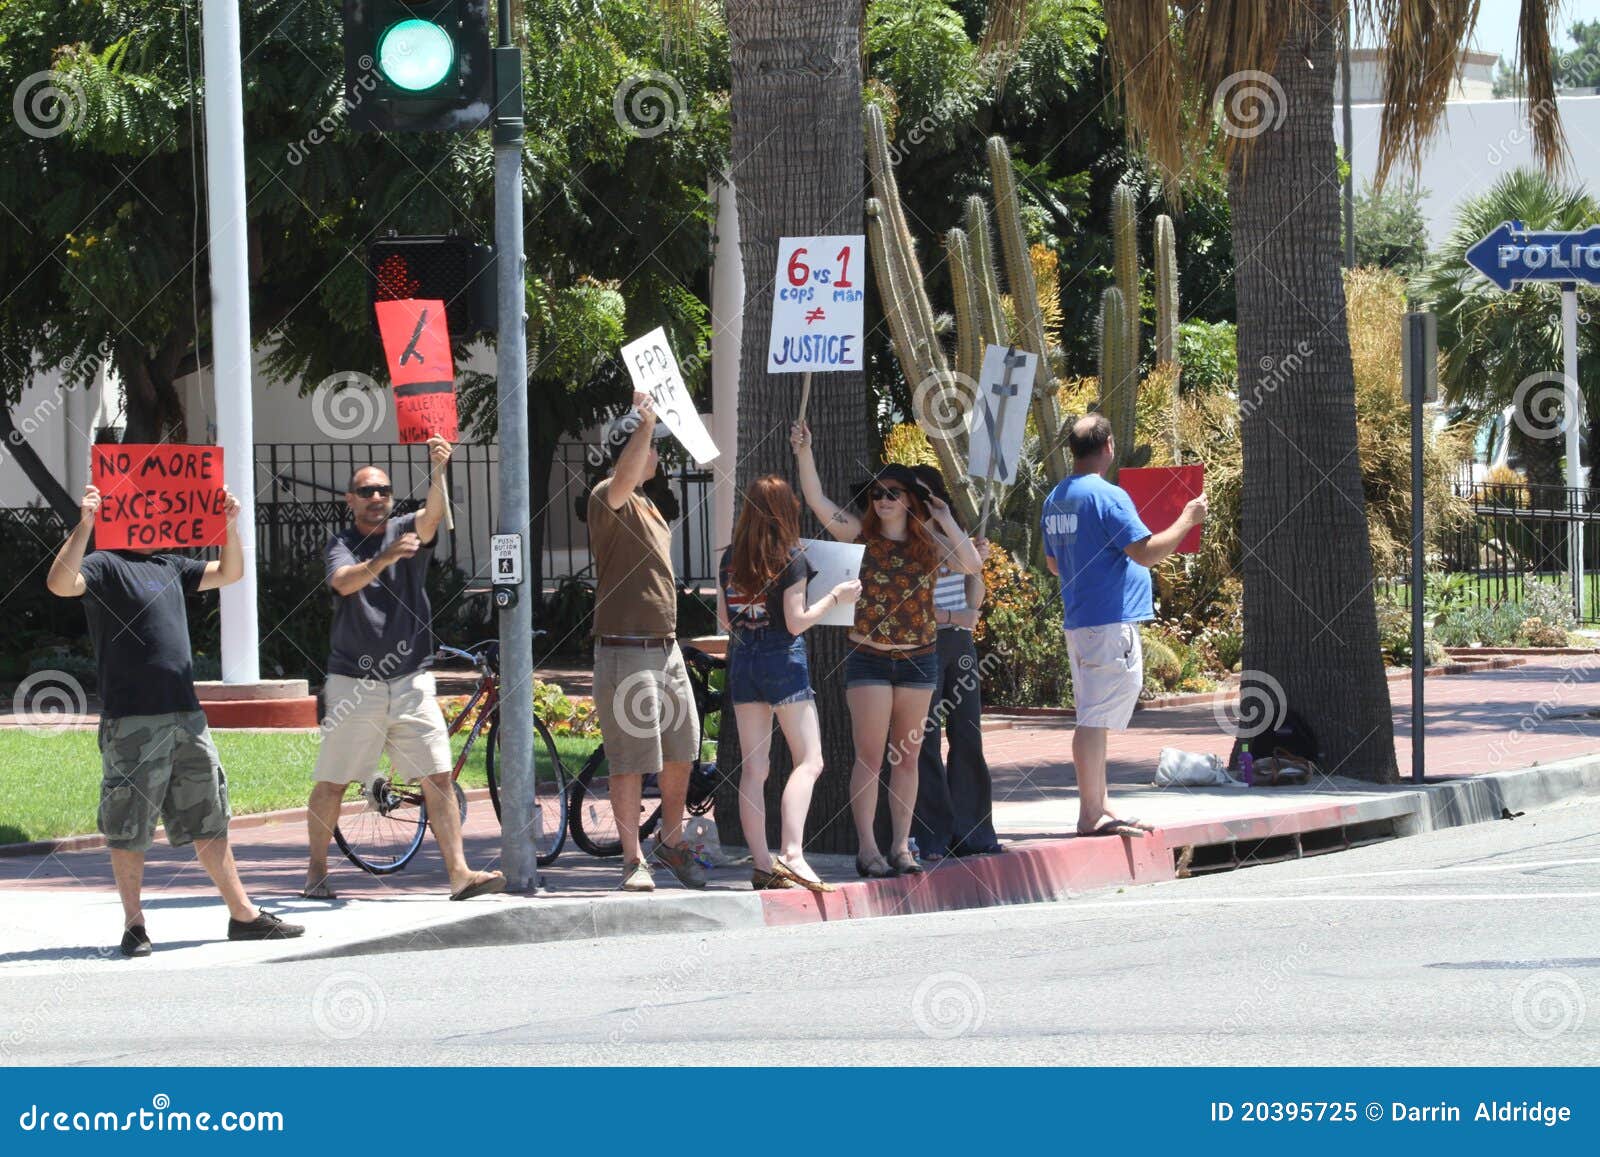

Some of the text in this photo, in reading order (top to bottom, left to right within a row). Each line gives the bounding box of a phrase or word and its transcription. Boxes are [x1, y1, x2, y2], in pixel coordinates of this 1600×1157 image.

[788, 247, 810, 287] 6
[833, 246, 852, 288] 1
[780, 286, 815, 304] cops
[635, 344, 668, 380] FPD
[773, 334, 856, 365] JUSTICE
[99, 451, 213, 480] NO MORE
[100, 487, 225, 522] EXCESSIVE
[127, 518, 204, 546] FORCE
